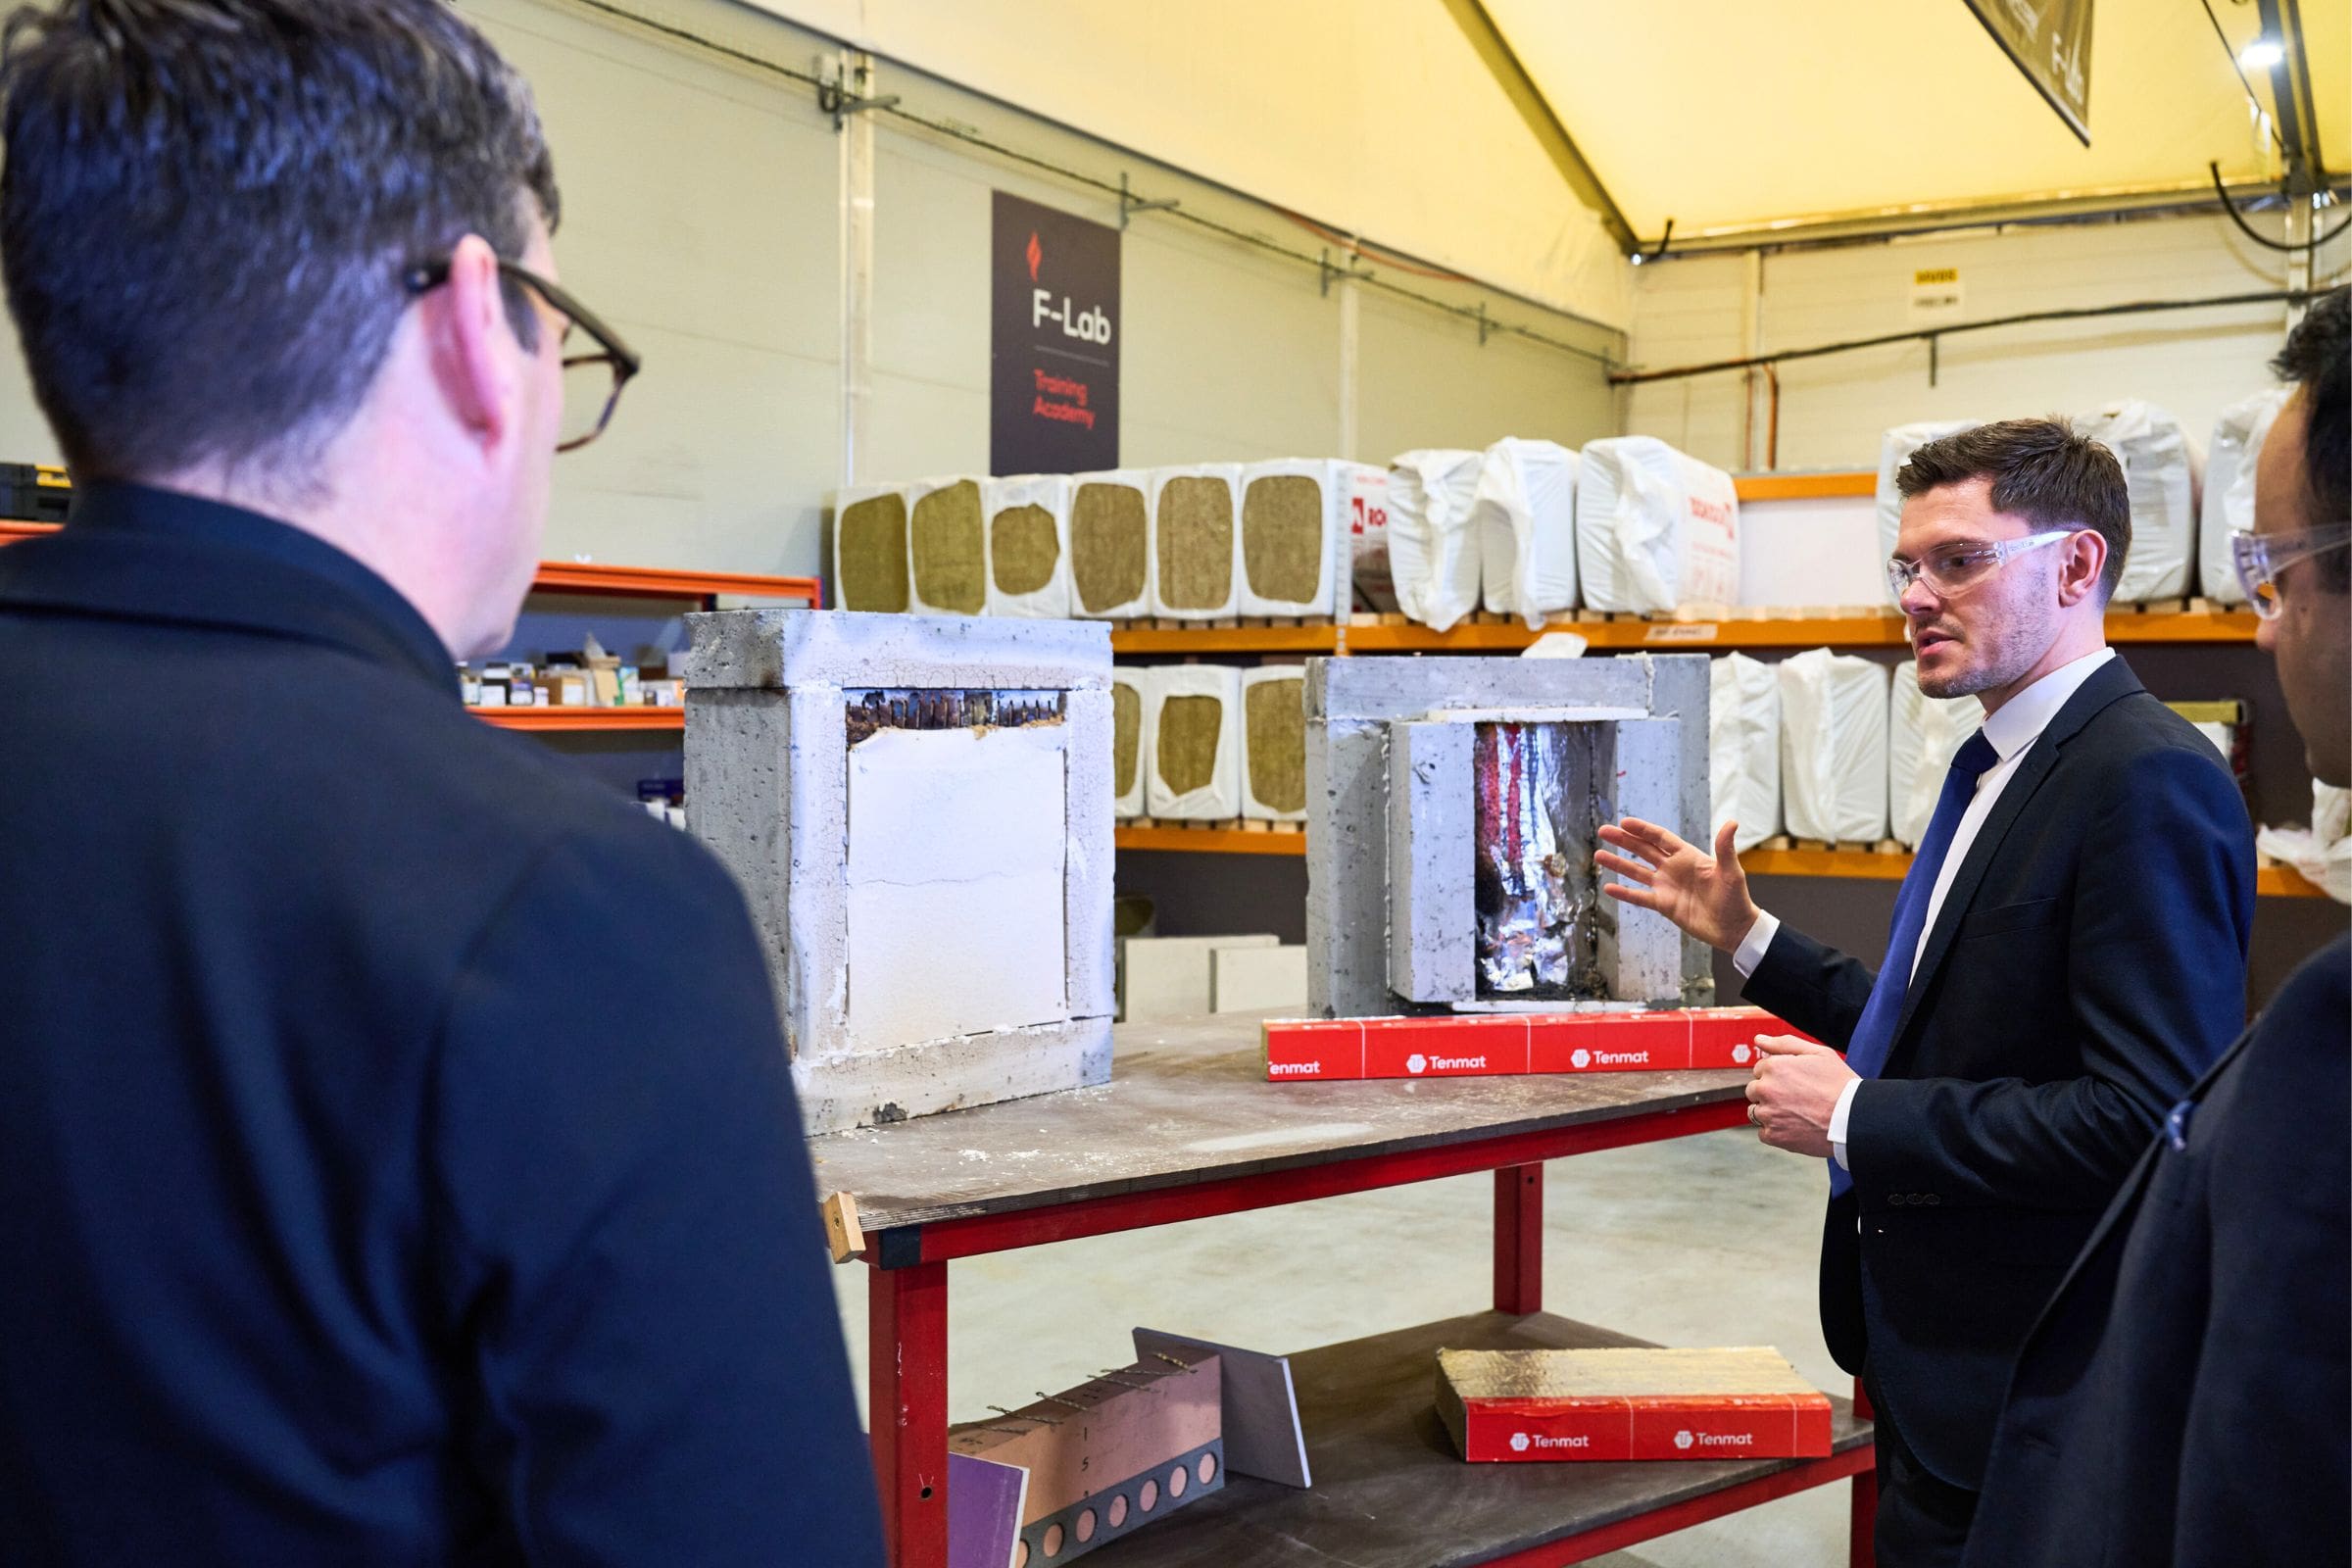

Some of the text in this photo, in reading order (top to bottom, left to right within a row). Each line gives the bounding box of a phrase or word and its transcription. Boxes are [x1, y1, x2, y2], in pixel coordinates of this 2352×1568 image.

[1033, 288, 1111, 345] F-Lab
[1034, 368, 1088, 407] Training
[1034, 394, 1096, 429] Academy
[1429, 1054, 1487, 1069] Tenmat
[1593, 1049, 1648, 1064] Tenmat
[1532, 1435, 1590, 1447] Tenmat
[1696, 1433, 1753, 1446] Tenmat
